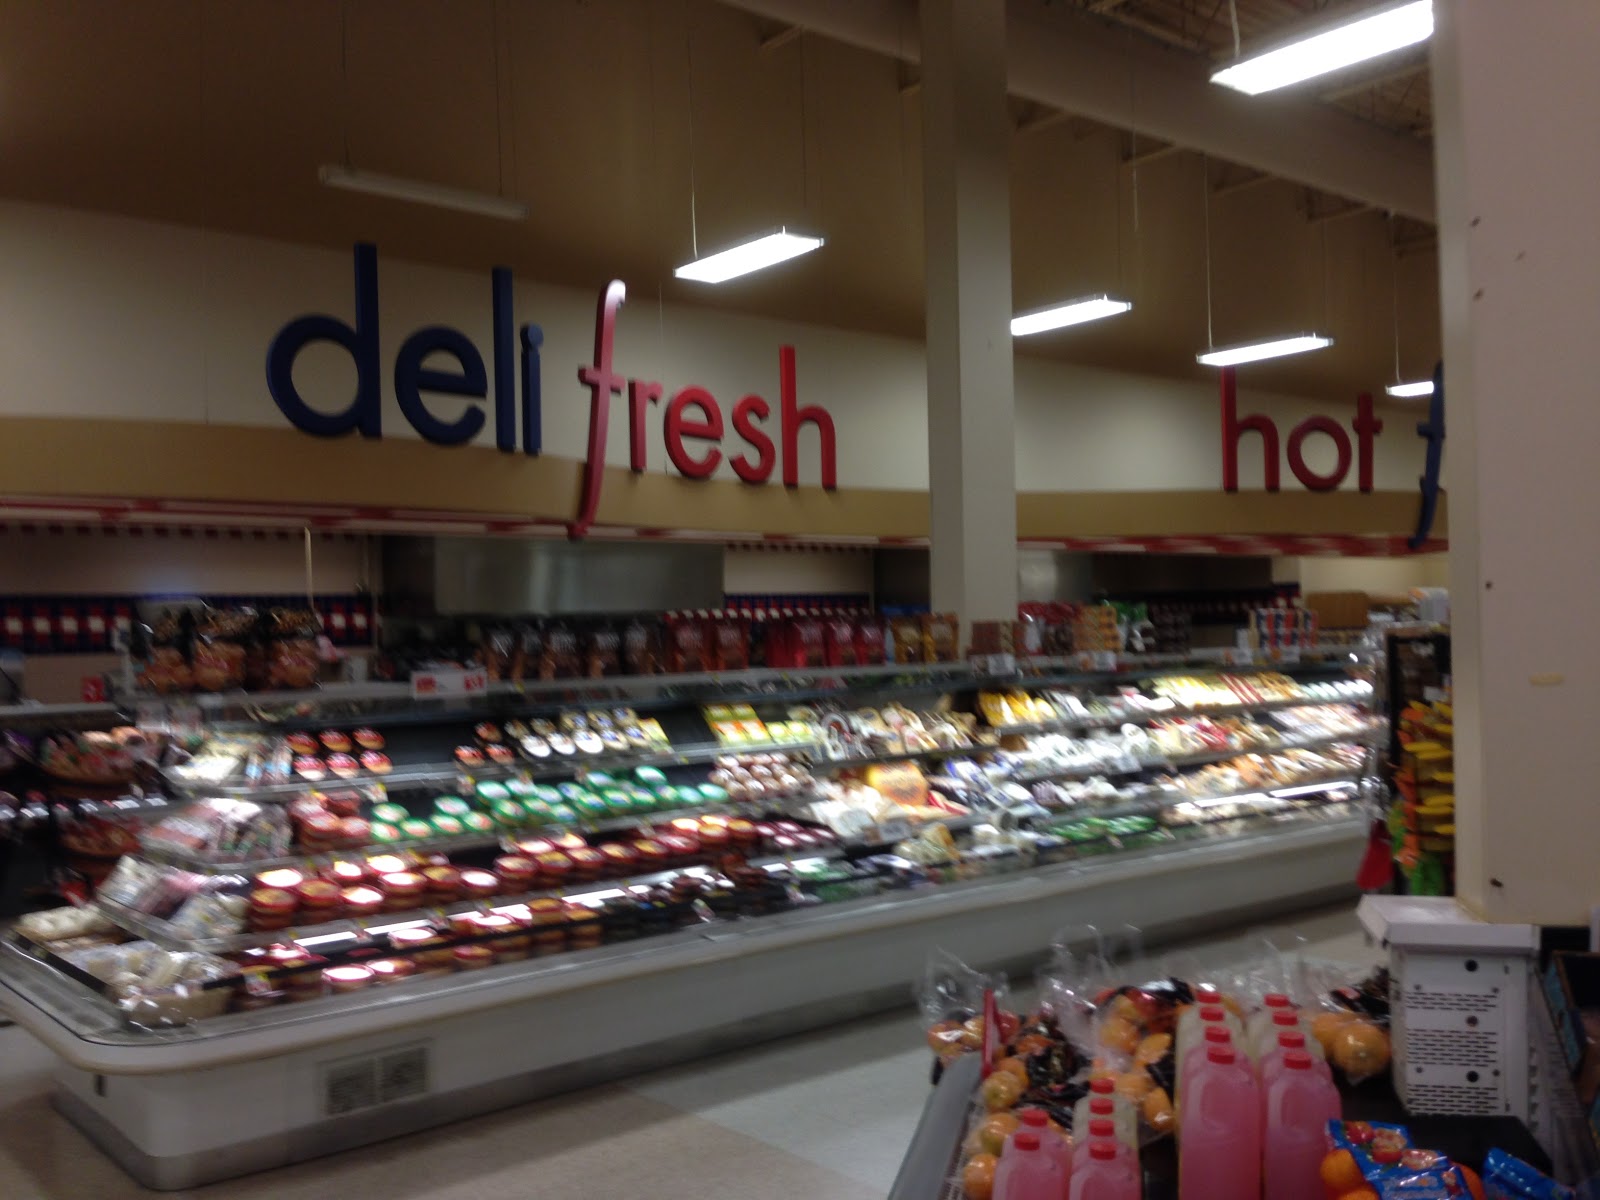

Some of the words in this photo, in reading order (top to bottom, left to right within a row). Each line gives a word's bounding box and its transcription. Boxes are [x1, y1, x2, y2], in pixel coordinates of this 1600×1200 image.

[266, 242, 544, 456] deli
[567, 279, 837, 541] fresh
[1220, 365, 1384, 493] hot
